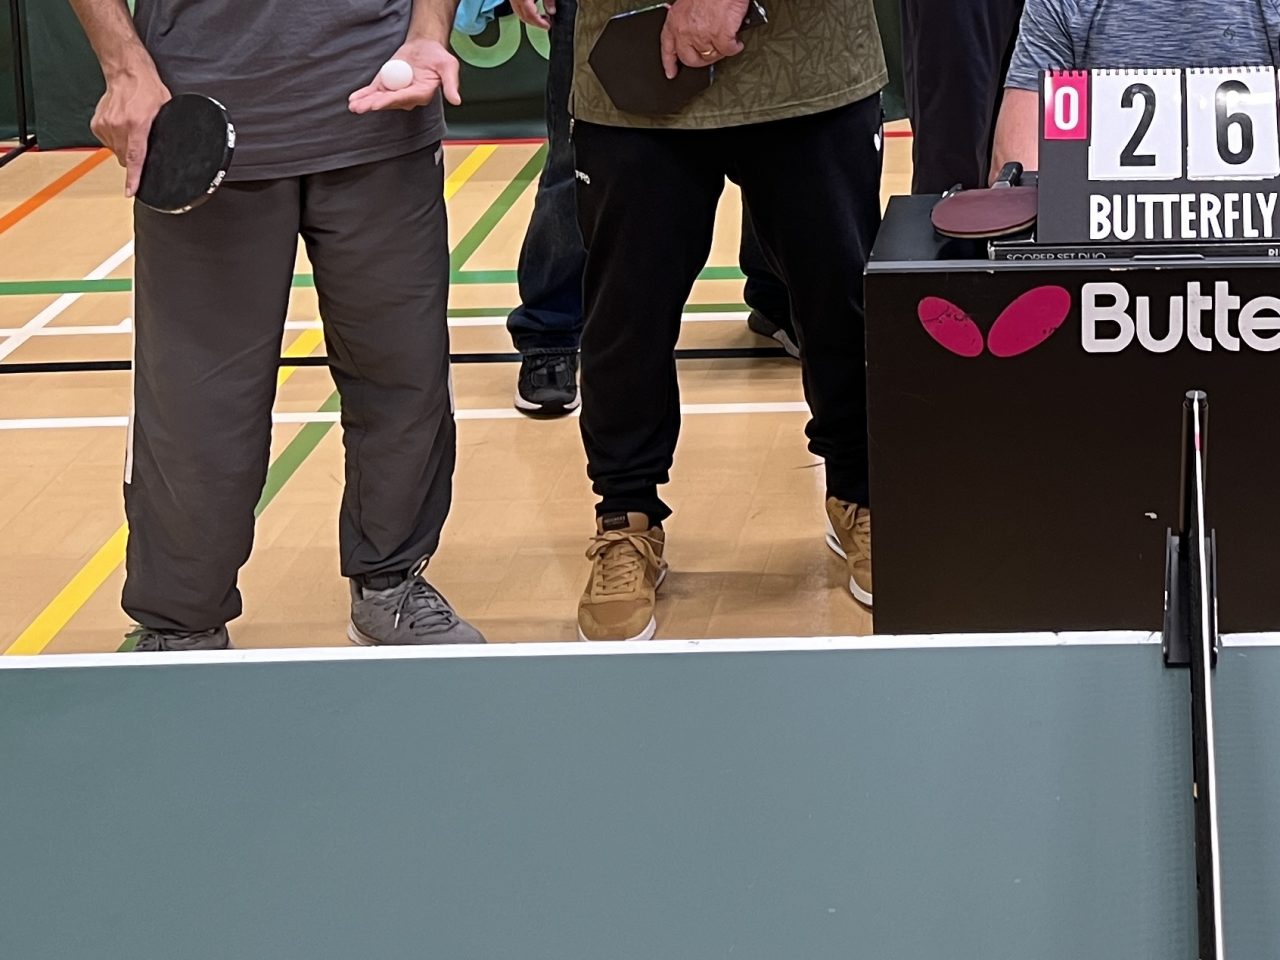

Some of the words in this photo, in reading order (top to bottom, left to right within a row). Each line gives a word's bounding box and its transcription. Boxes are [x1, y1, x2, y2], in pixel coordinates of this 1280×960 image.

[1054, 86, 1080, 131] 0
[1119, 82, 1157, 167] 2
[1215, 79, 1254, 165] 6
[1089, 192, 1278, 241] BUTTERFLY
